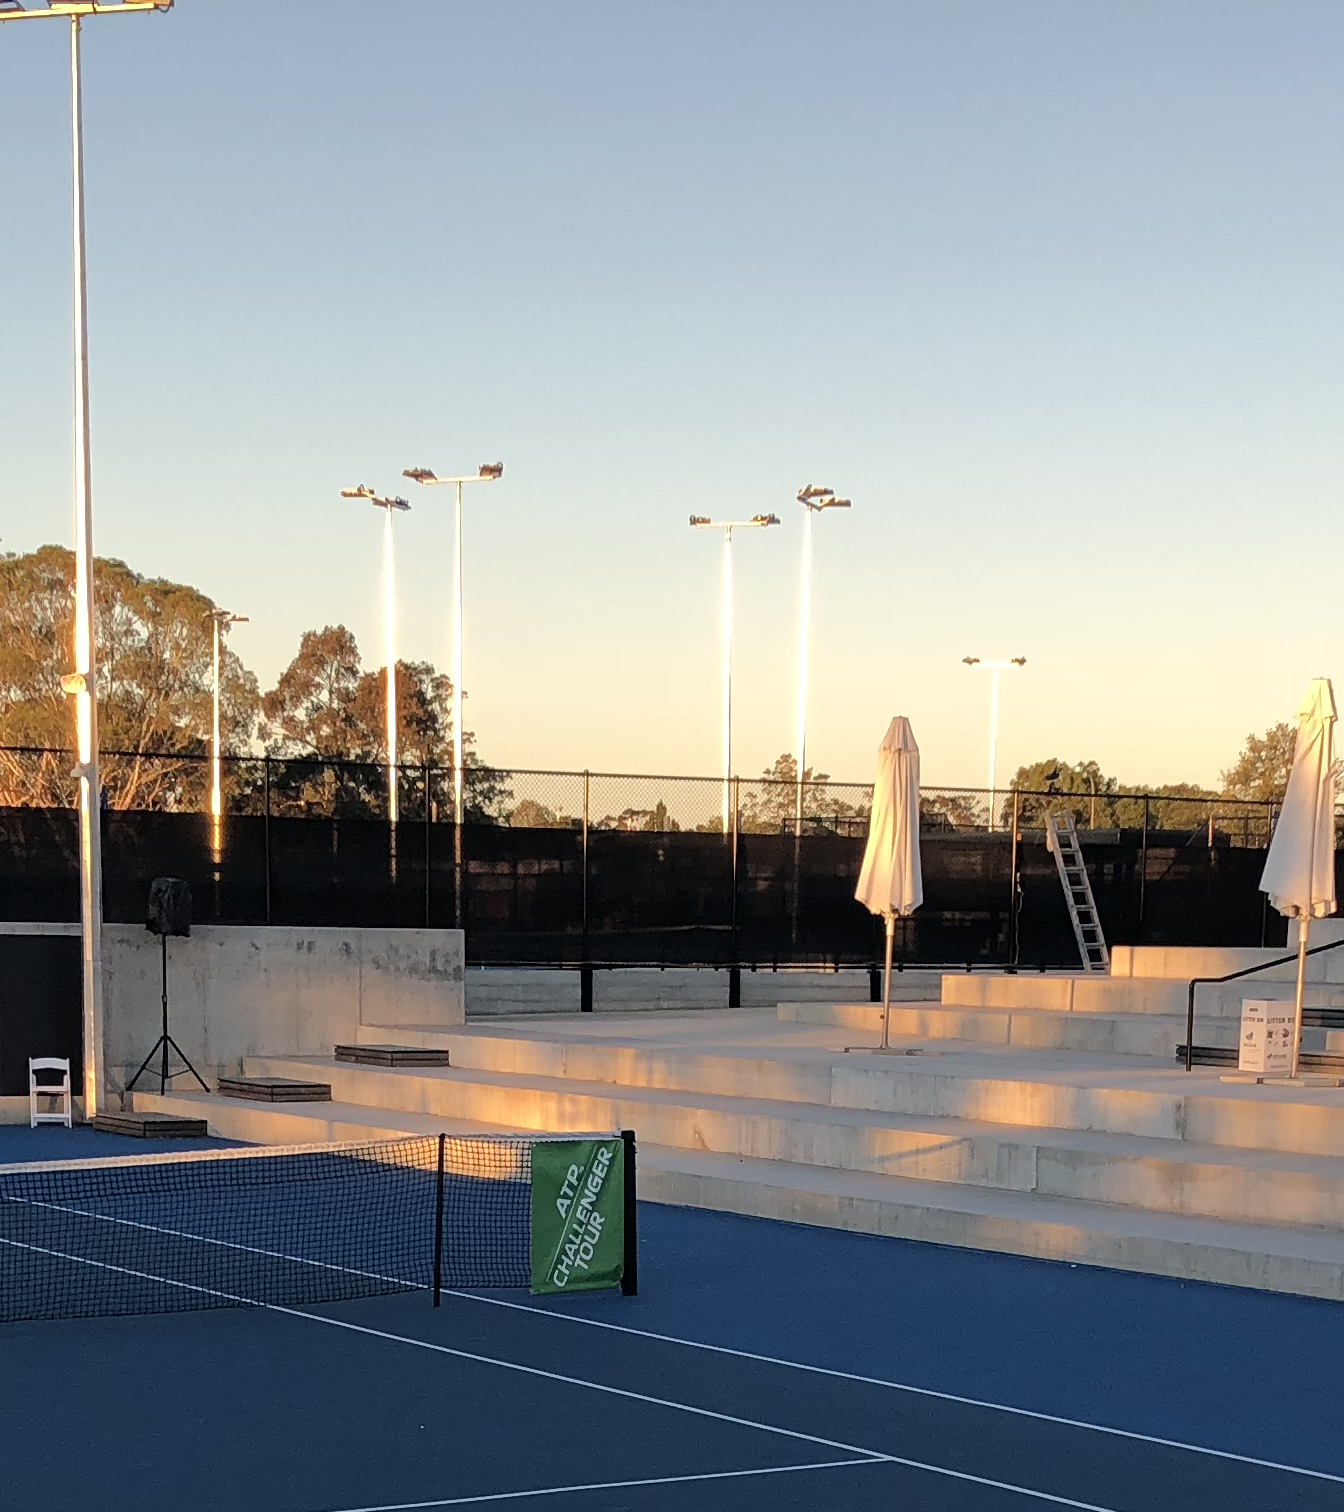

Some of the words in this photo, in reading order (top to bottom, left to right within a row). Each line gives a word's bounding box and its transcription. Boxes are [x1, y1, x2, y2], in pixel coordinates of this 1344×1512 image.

[553, 1146, 613, 1287] CHALLENGER
[556, 1164, 581, 1219] ATP
[574, 1211, 605, 1270] TOUR
